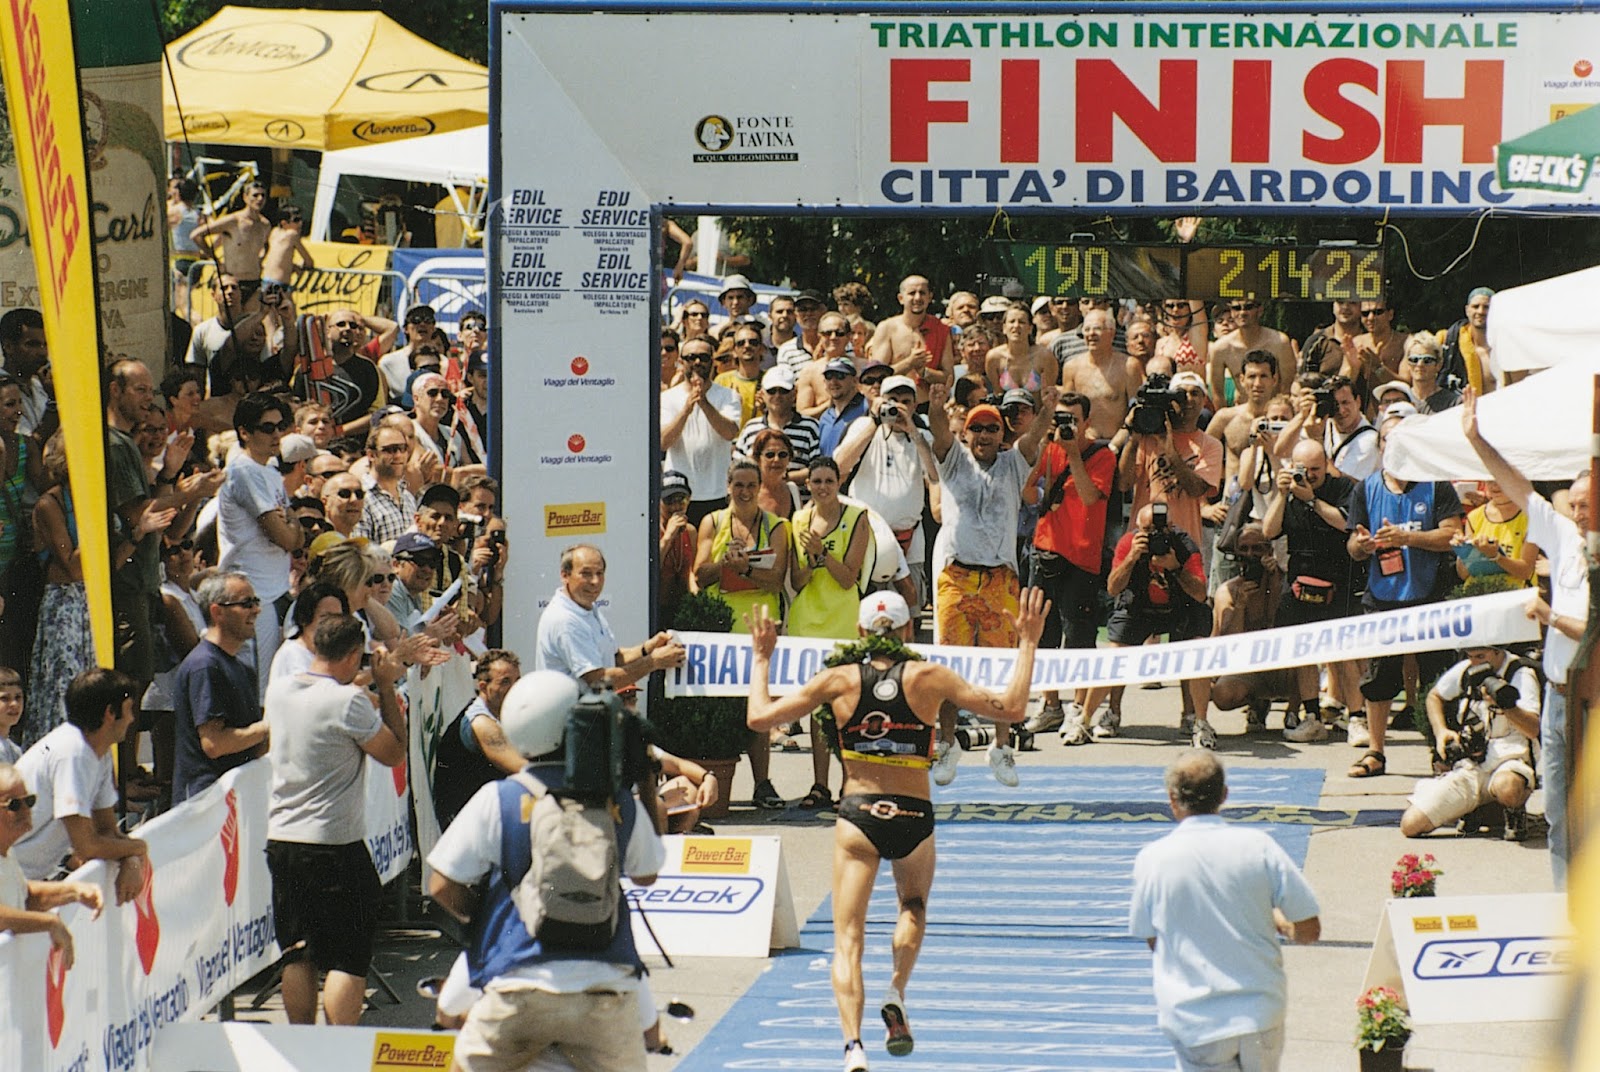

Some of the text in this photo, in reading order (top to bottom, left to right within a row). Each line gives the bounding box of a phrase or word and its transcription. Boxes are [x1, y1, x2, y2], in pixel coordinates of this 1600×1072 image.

[871, 22, 1518, 48] TRIATHLON INTERNAZIONALE
[889, 57, 1505, 164] FINISH
[737, 117, 793, 129] FONTE
[736, 132, 794, 147] TAVINA
[1086, 169, 1144, 202] DI
[512, 189, 547, 206] EDIL
[581, 209, 649, 226] SERVICE
[511, 252, 547, 269] EDIL
[597, 254, 633, 270] EDIL
[1025, 246, 1109, 295] 190
[1219, 249, 1381, 300] 2.14.26
[581, 272, 649, 289] SERVICE
[544, 378, 615, 387] Viaggi del Ventaglio
[541, 454, 612, 465] Viaggi del Ventaglio
[548, 509, 602, 525] PowerBar
[1250, 637, 1282, 665] DI
[1294, 604, 1473, 659] BARDOLINO
[685, 846, 748, 862] PowerBar
[622, 884, 742, 904] eebok
[375, 1043, 451, 1065] PowerBar
